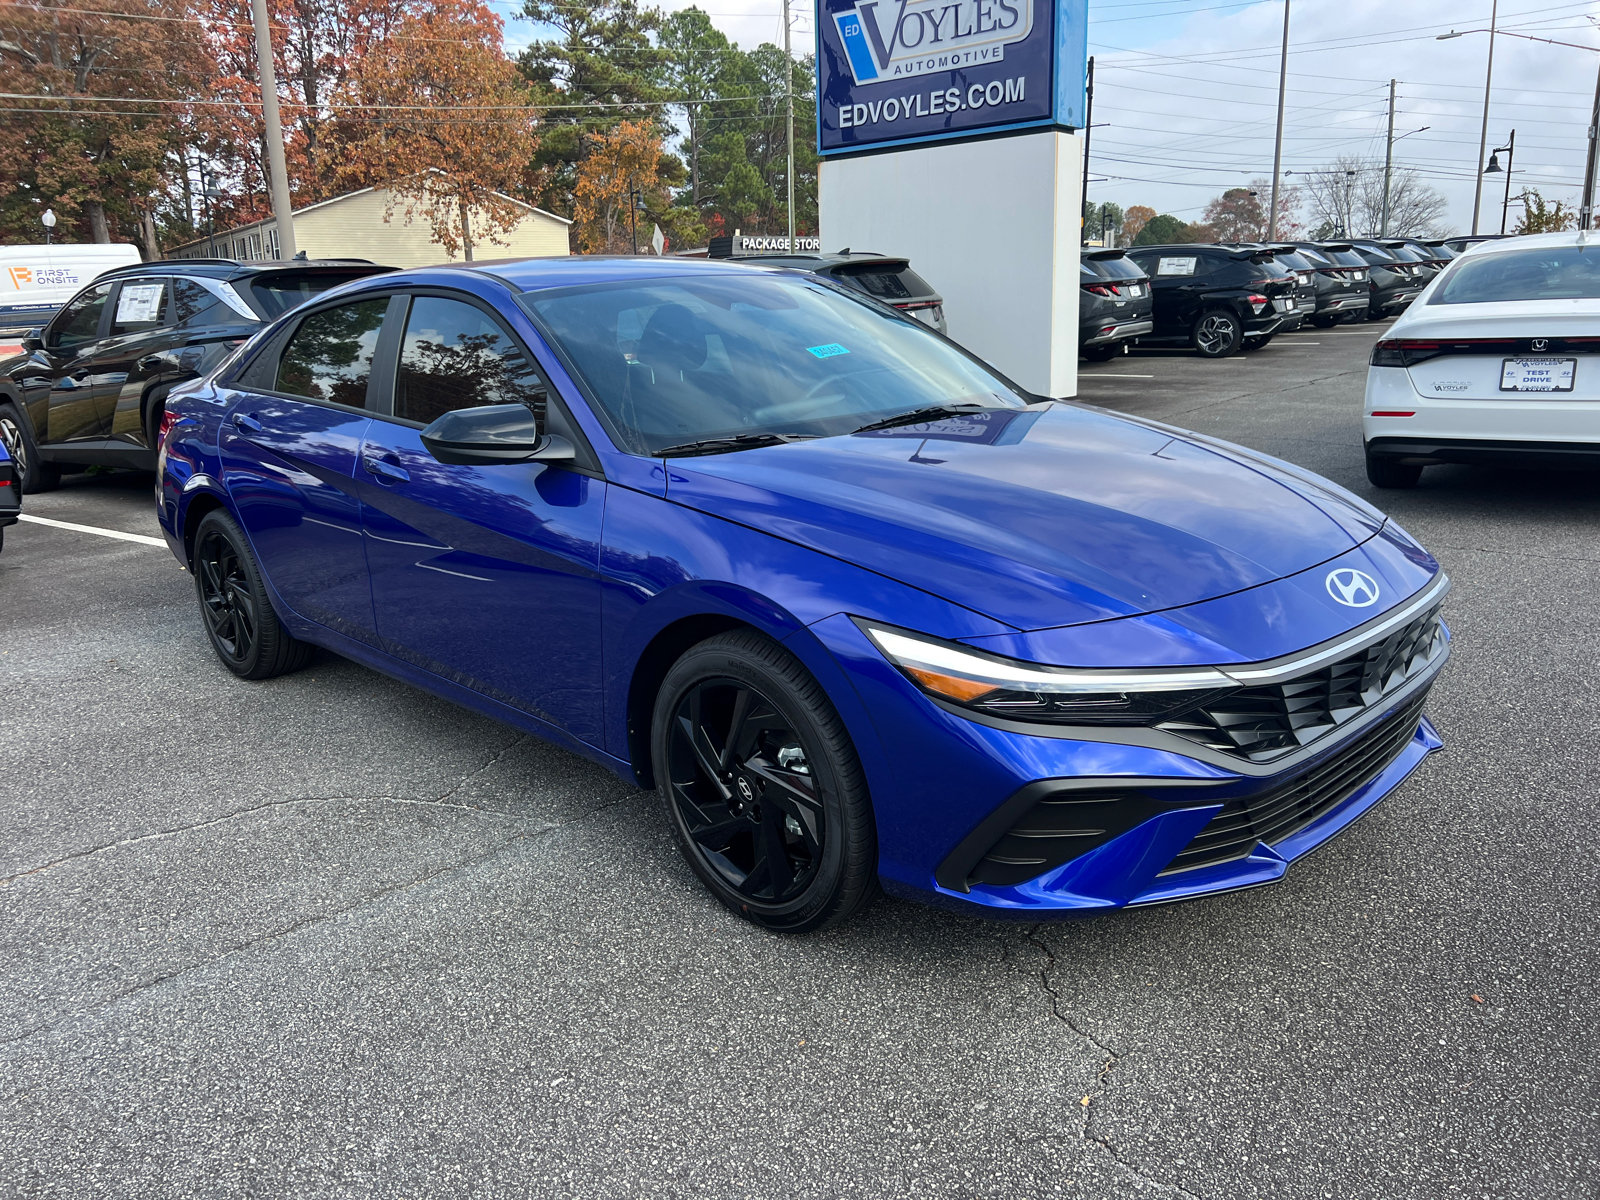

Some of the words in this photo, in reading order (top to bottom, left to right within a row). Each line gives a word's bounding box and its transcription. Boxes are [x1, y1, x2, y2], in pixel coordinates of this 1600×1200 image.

[844, 24, 860, 37] ED
[858, 0, 1019, 70] VOYLES
[894, 47, 1000, 75] AUTOMOTIVE
[838, 76, 1026, 128] EDVOYLES.COM
[742, 237, 790, 250] PACKAGE
[38, 276, 78, 284] ONSITE
